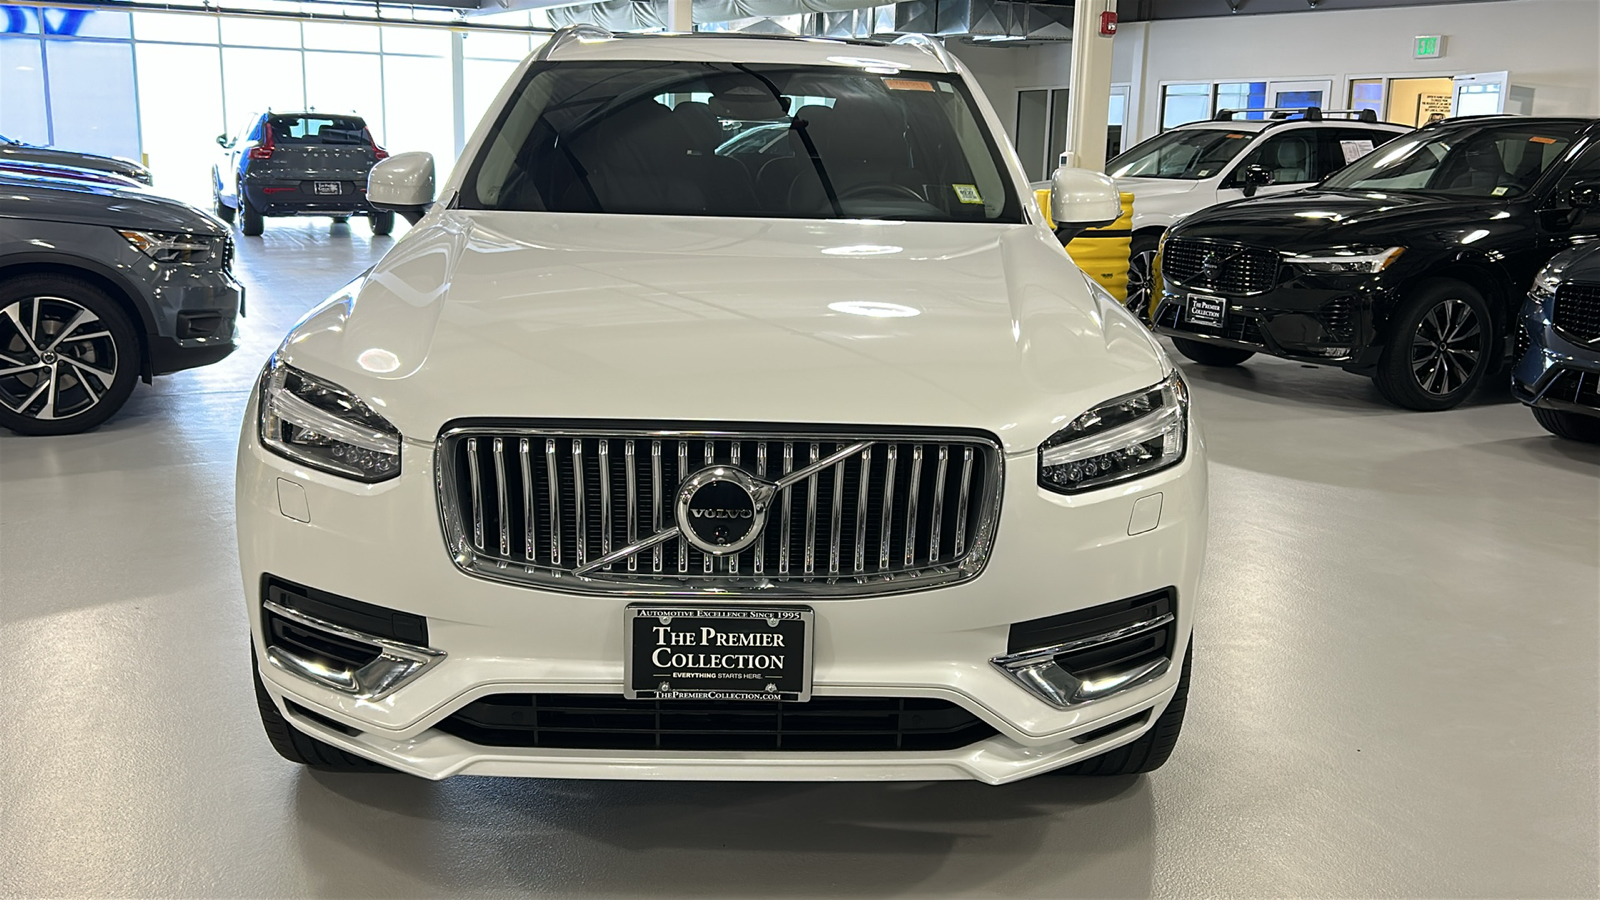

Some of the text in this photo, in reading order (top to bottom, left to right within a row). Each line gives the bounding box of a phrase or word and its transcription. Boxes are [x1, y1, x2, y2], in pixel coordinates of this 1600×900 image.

[1191, 307, 1220, 318] COLLECTION
[690, 508, 753, 519] VOLVO
[639, 609, 800, 619] AUTOMOTIVE EXCELLENCE SINCE 1995
[652, 626, 786, 648] THE PREMIER
[652, 647, 785, 670] COLLECTION
